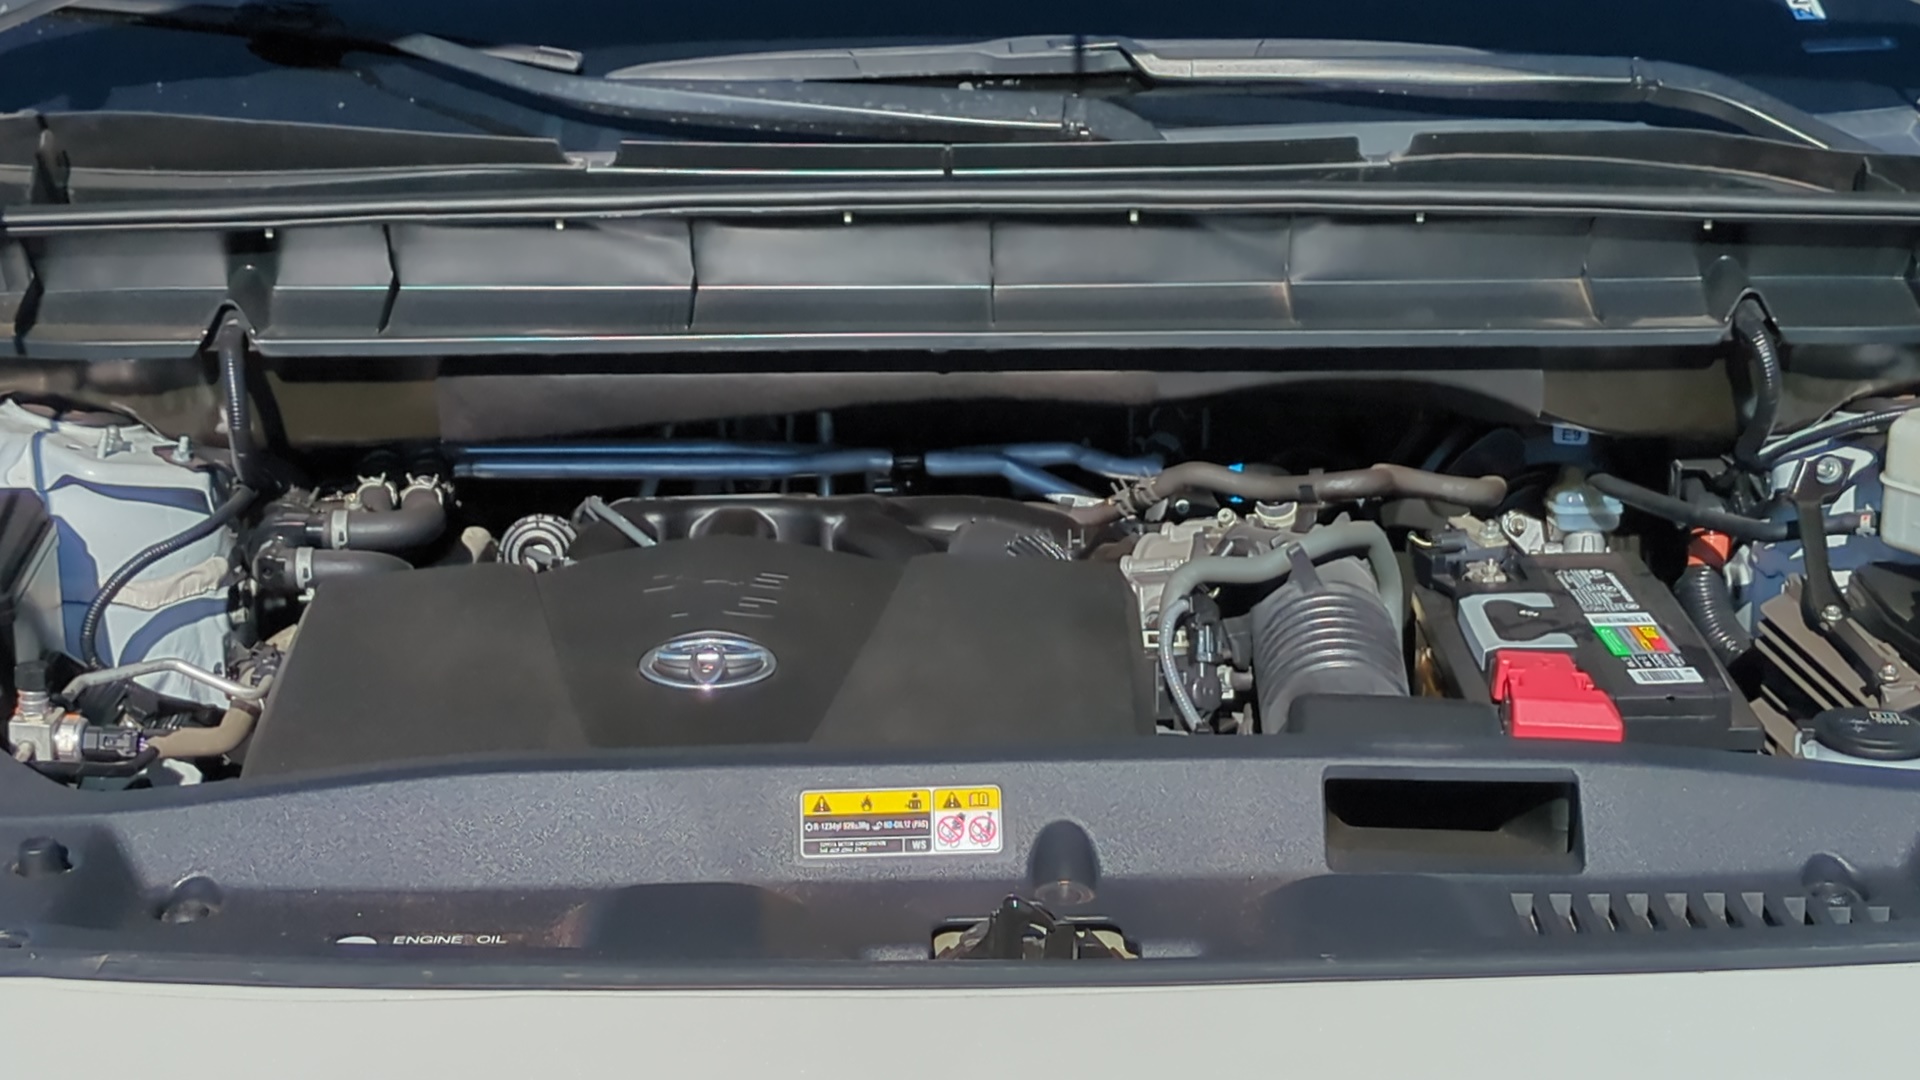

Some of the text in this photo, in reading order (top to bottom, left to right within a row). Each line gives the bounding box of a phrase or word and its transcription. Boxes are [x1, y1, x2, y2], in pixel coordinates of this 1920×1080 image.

[911, 839, 927, 850] WS
[393, 934, 507, 945] ENGINE OIL
